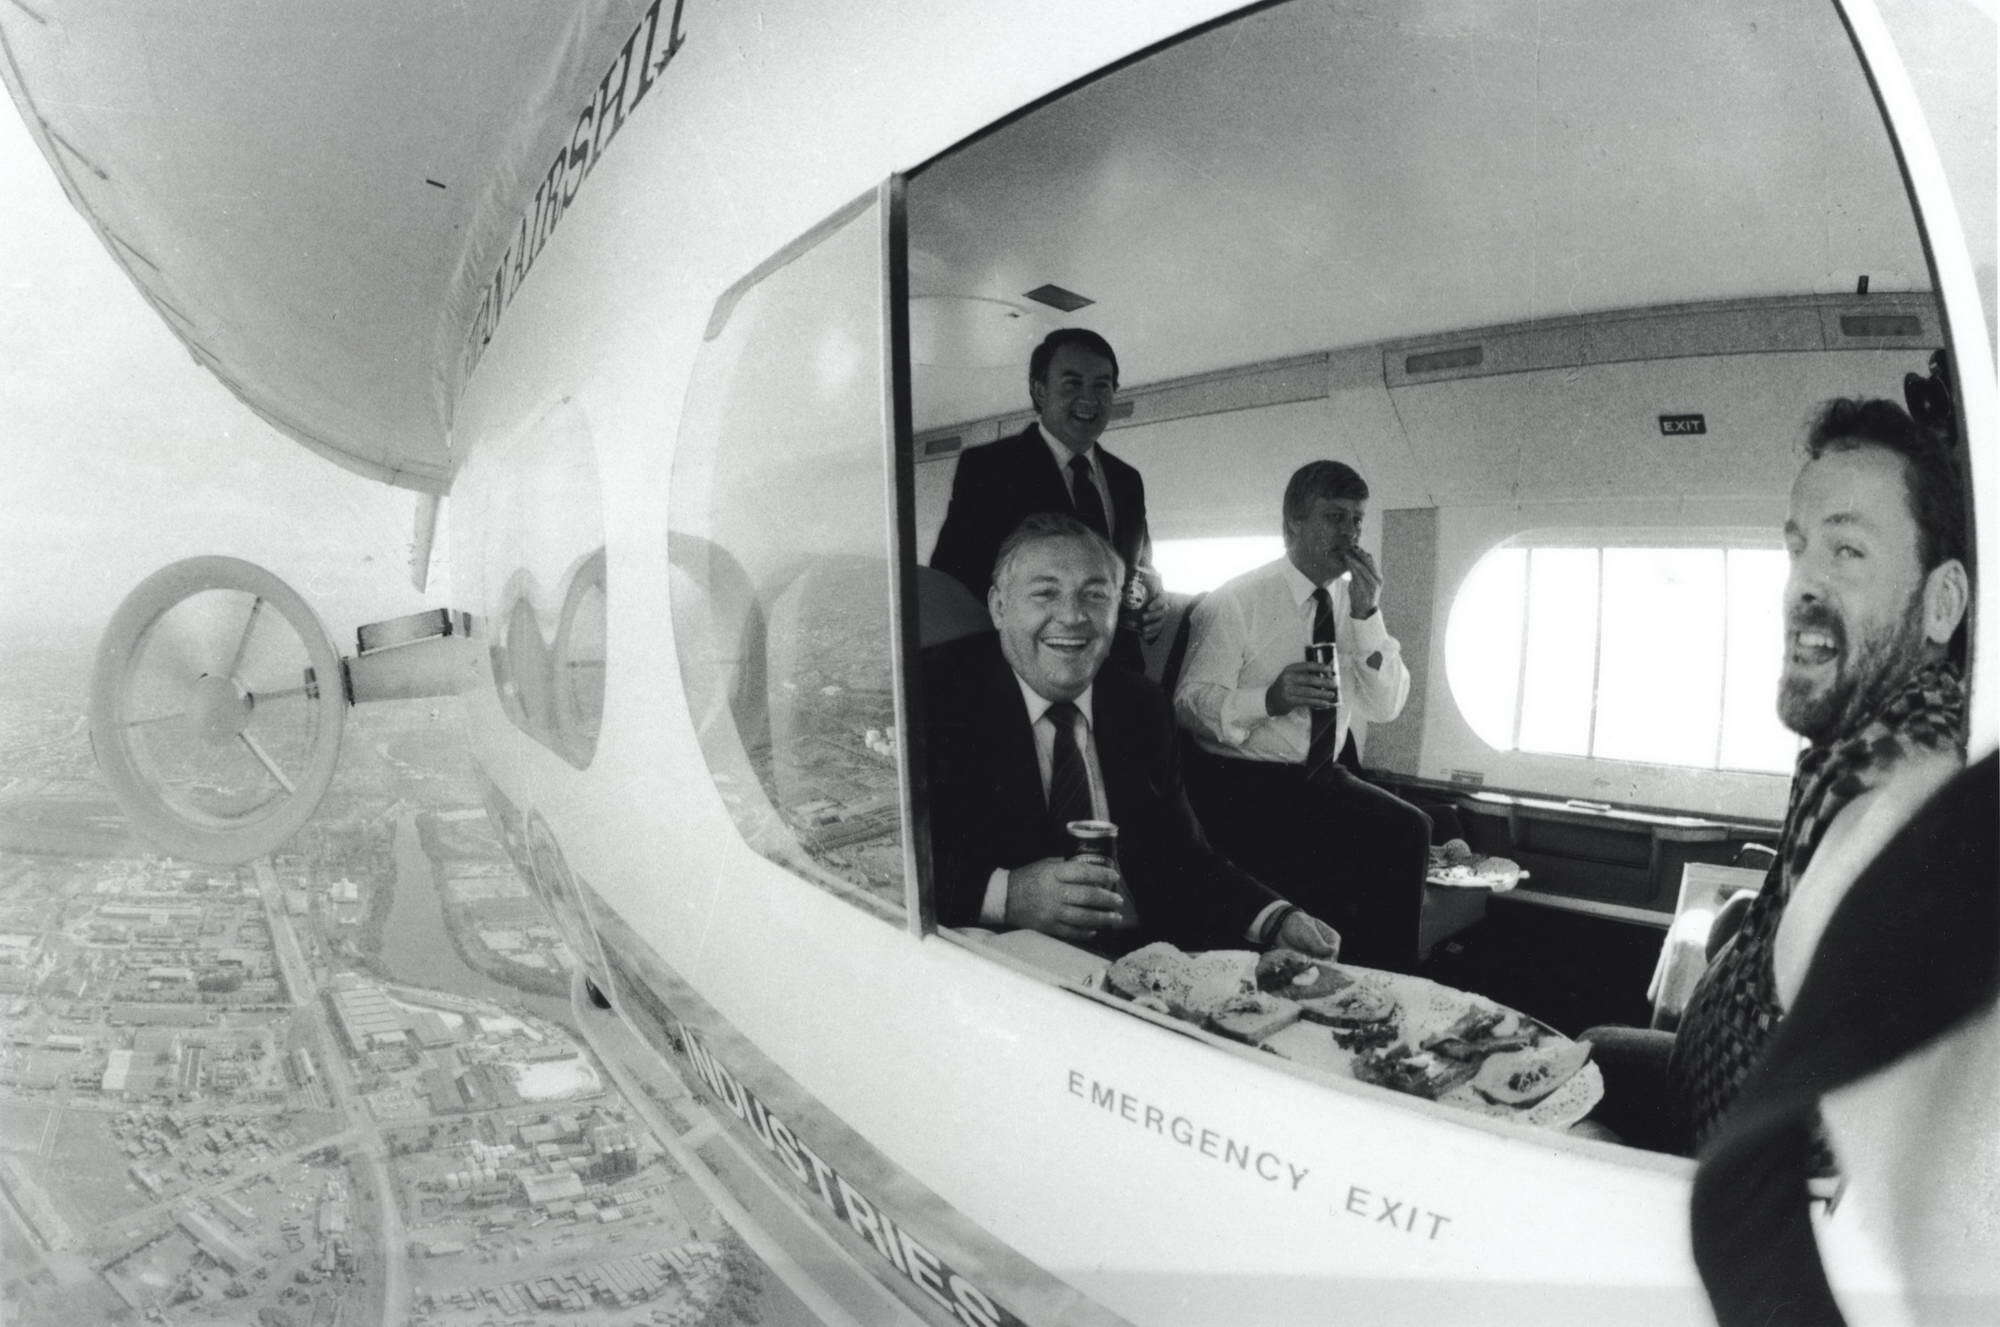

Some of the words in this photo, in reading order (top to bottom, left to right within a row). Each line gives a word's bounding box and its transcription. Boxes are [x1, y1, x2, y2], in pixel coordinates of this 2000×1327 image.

[1663, 420, 1701, 432] EXIT
[678, 1021, 1002, 1327] INDUSTRIES
[1067, 1069, 1310, 1192] EMERGENCY
[1344, 1185, 1452, 1240] EXIT
